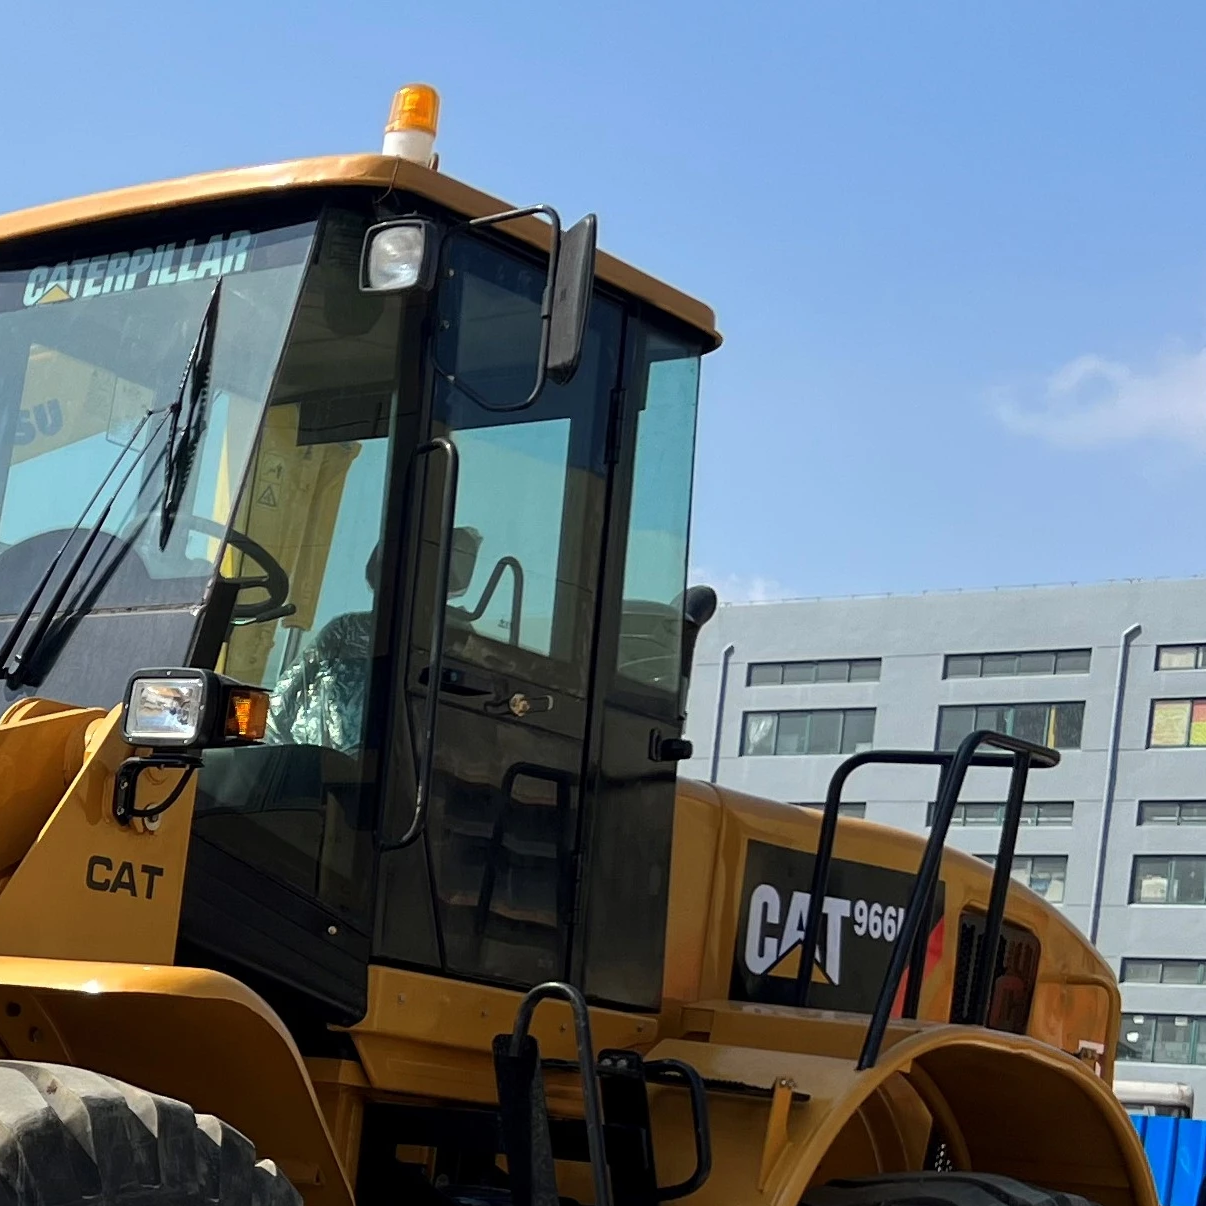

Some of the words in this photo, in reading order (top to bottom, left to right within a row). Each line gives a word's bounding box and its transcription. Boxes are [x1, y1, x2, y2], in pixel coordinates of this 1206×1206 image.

[23, 230, 251, 307] CATERPILLAR
[86, 855, 164, 900] CAT
[744, 883, 851, 986] CAT
[853, 899, 905, 942] 966
